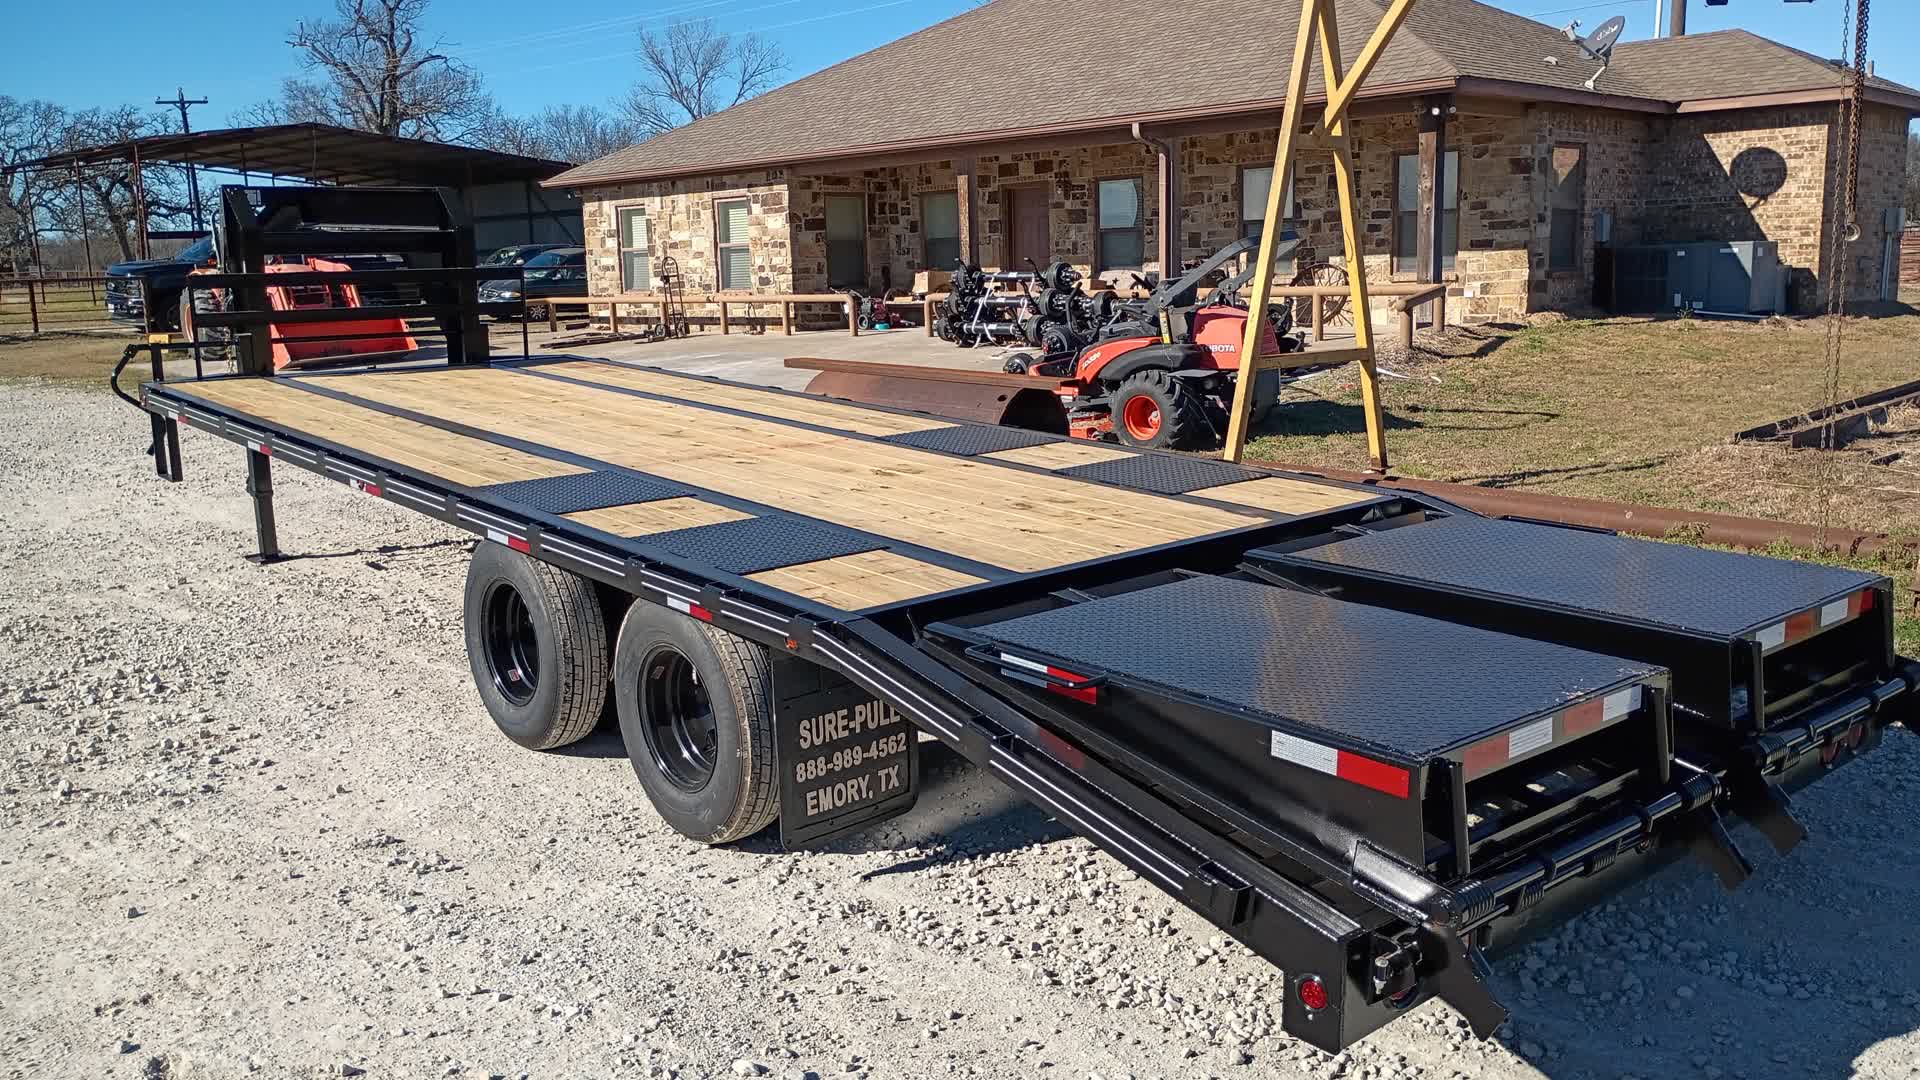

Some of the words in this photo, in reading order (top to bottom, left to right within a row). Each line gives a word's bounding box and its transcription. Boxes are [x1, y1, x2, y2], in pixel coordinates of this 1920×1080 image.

[799, 699, 901, 750] SURE-PULL
[796, 732, 906, 783] 888-989-4562
[806, 774, 874, 816] EMORY,
[878, 764, 900, 792] TX
